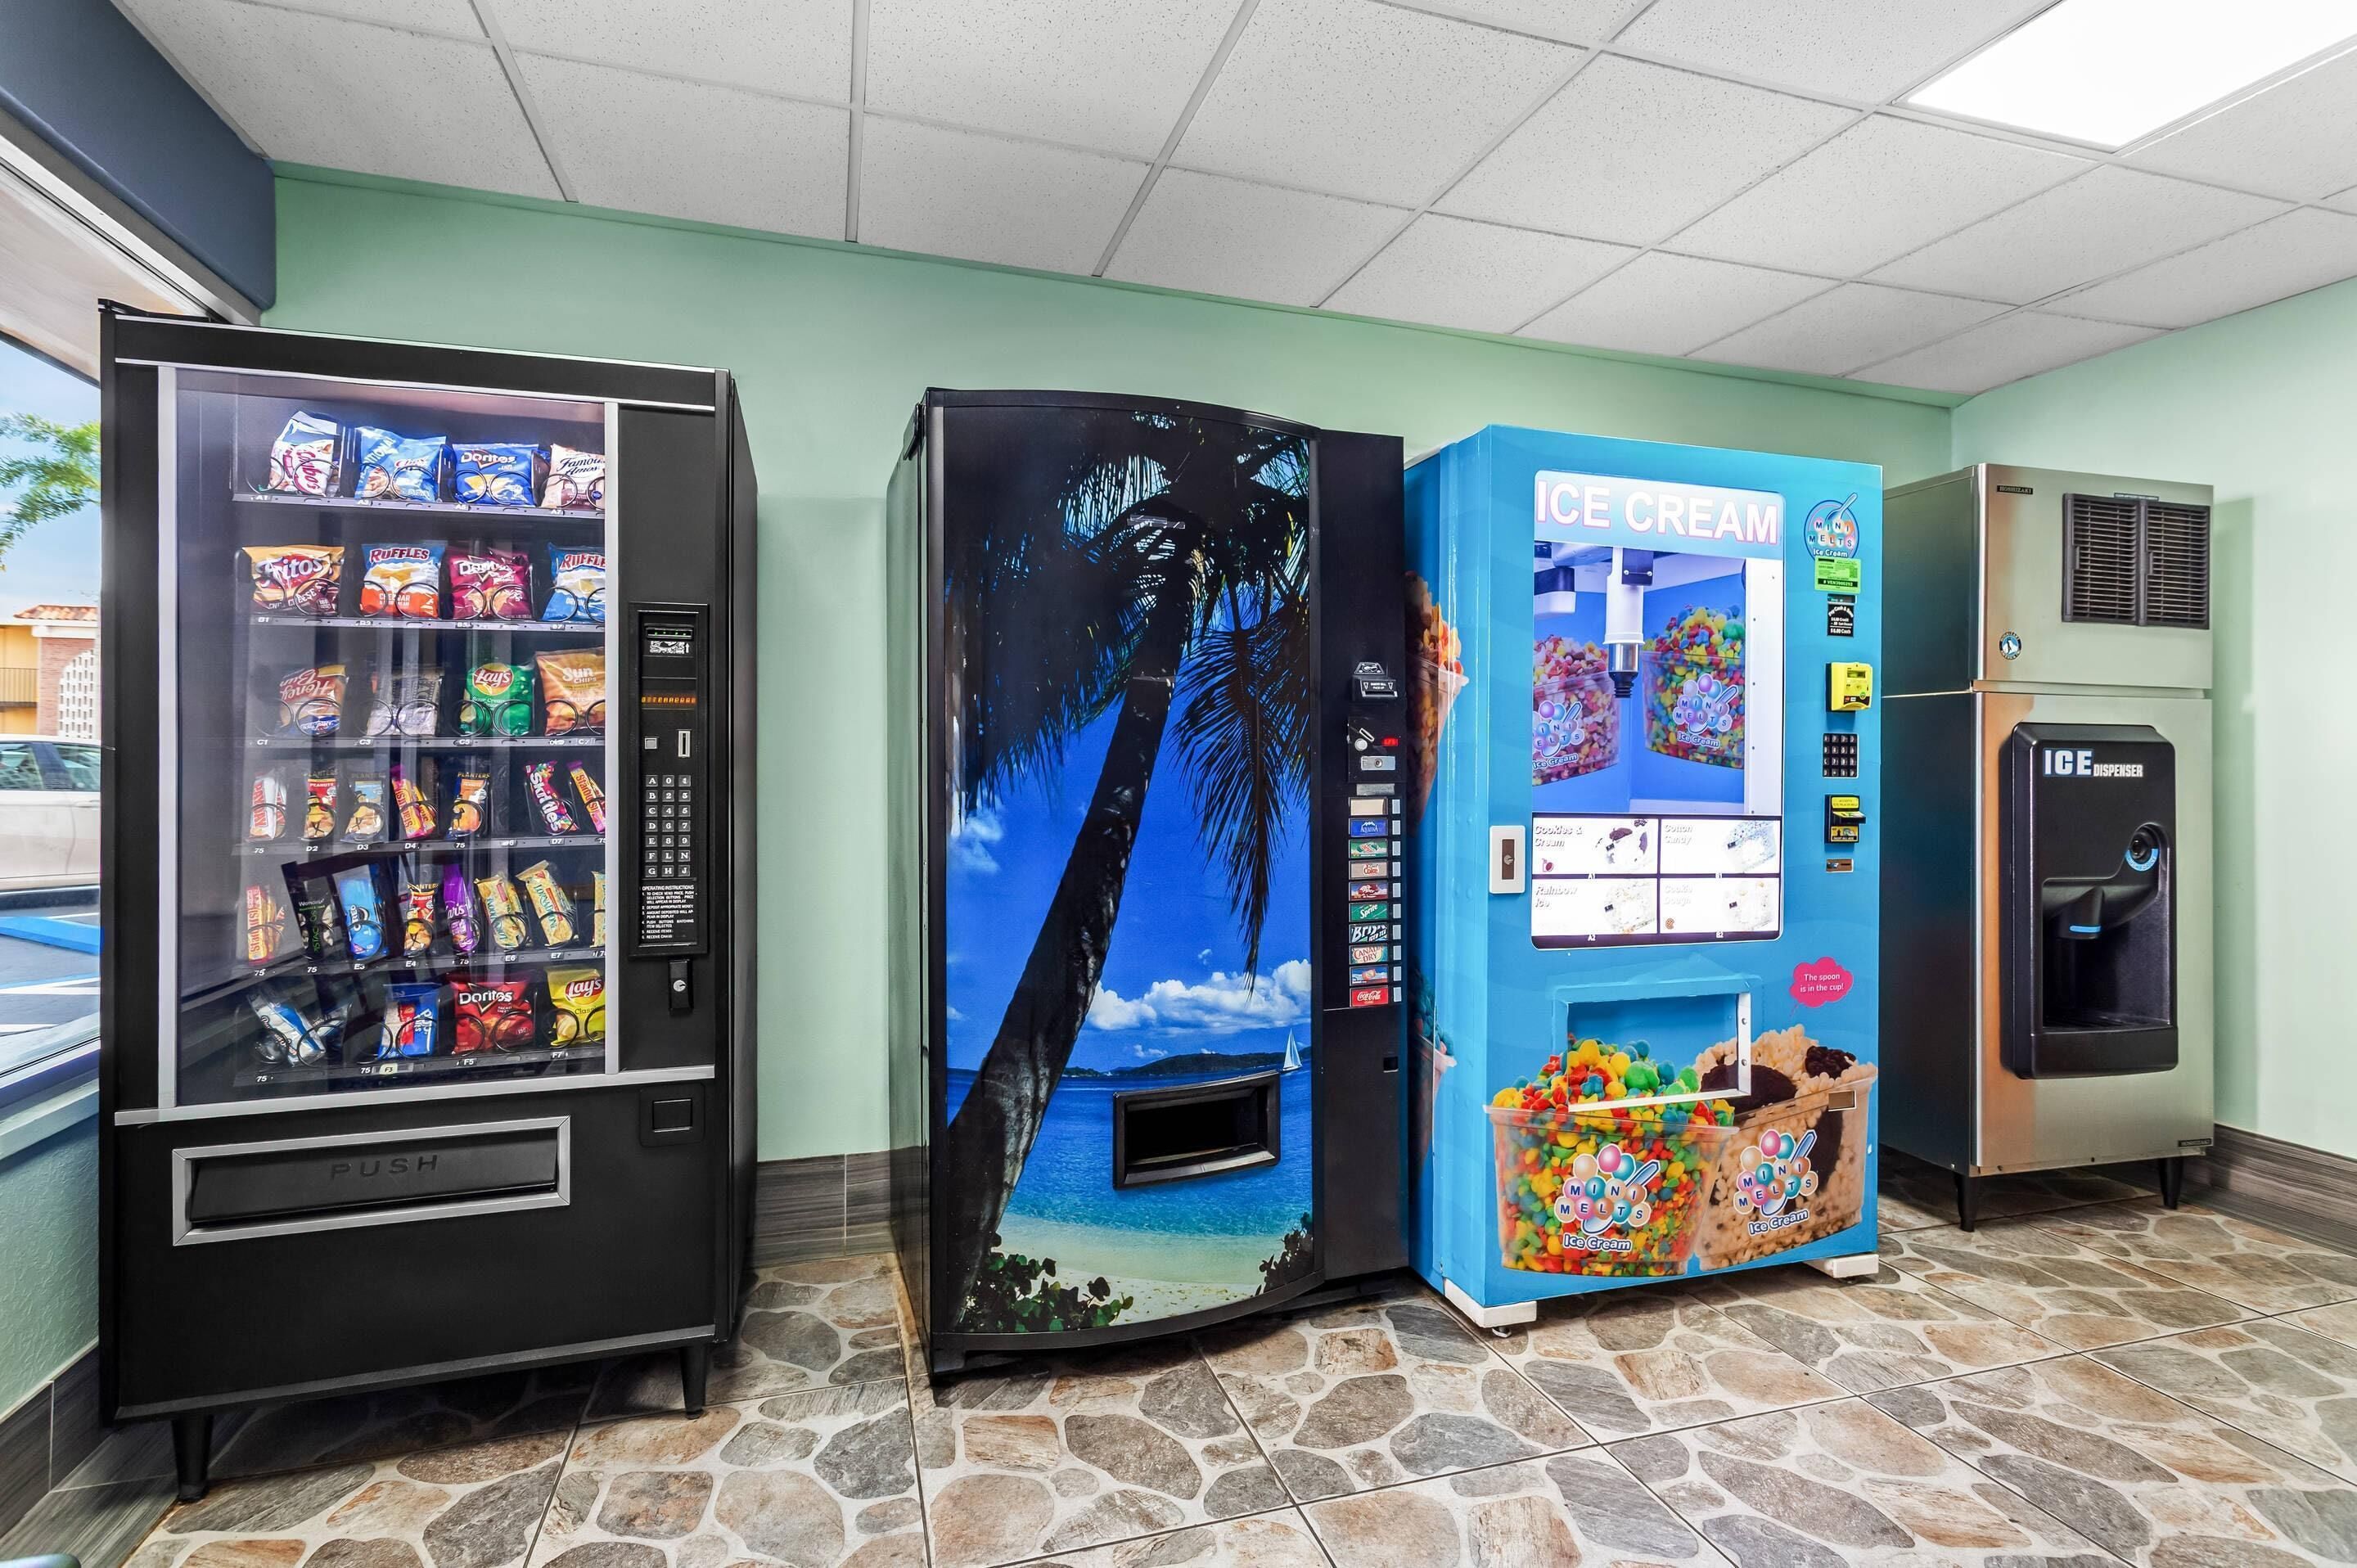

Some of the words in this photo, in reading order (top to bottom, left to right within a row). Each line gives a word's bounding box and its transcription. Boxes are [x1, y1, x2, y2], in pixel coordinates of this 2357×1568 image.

[461, 452, 516, 463] Doritos
[1536, 480, 1611, 529] ICE
[1625, 491, 1778, 545] CREAM
[1815, 521, 1849, 532] MINI
[1809, 534, 1852, 547] MELTS
[370, 547, 430, 564] RUFFLES
[255, 557, 322, 579] Fritos
[475, 669, 512, 688] Lay's
[563, 667, 594, 683] Sun
[281, 680, 334, 701] Honey
[1681, 701, 1724, 713] MINI
[1675, 711, 1728, 727] MELTS
[1535, 733, 1580, 747] ELTS
[1679, 732, 1692, 742] Ice
[1691, 735, 1719, 747] Cream
[1533, 759, 1548, 769] Ice
[1548, 754, 1579, 766] Cream
[2044, 750, 2092, 776] ICE
[2093, 764, 2143, 777] DISPENSER
[575, 773, 598, 813] Starbust
[1535, 825, 1573, 835] Cookies
[1535, 885, 1578, 896] Rainbow
[350, 904, 362, 932] OREO
[1359, 904, 1378, 920] Sprite
[1363, 952, 1377, 963] DRY
[1804, 973, 1817, 981] The
[1818, 974, 1840, 982] spoon
[567, 978, 603, 998] Lay's
[1800, 985, 1806, 993] is
[1808, 984, 1814, 992] in
[1829, 983, 1844, 991] cup!
[459, 990, 513, 1005] Doritos
[331, 1155, 438, 1181] PUSH
[1743, 1164, 1802, 1187] MINI
[1570, 1184, 1637, 1201] MINI
[1739, 1178, 1812, 1207] MELTS
[1560, 1204, 1643, 1219] MELTS
[1749, 1221, 1769, 1235] Ice
[1769, 1210, 1809, 1230] Cream
[1564, 1234, 1586, 1248] Ice
[1586, 1237, 1632, 1251] Cream
